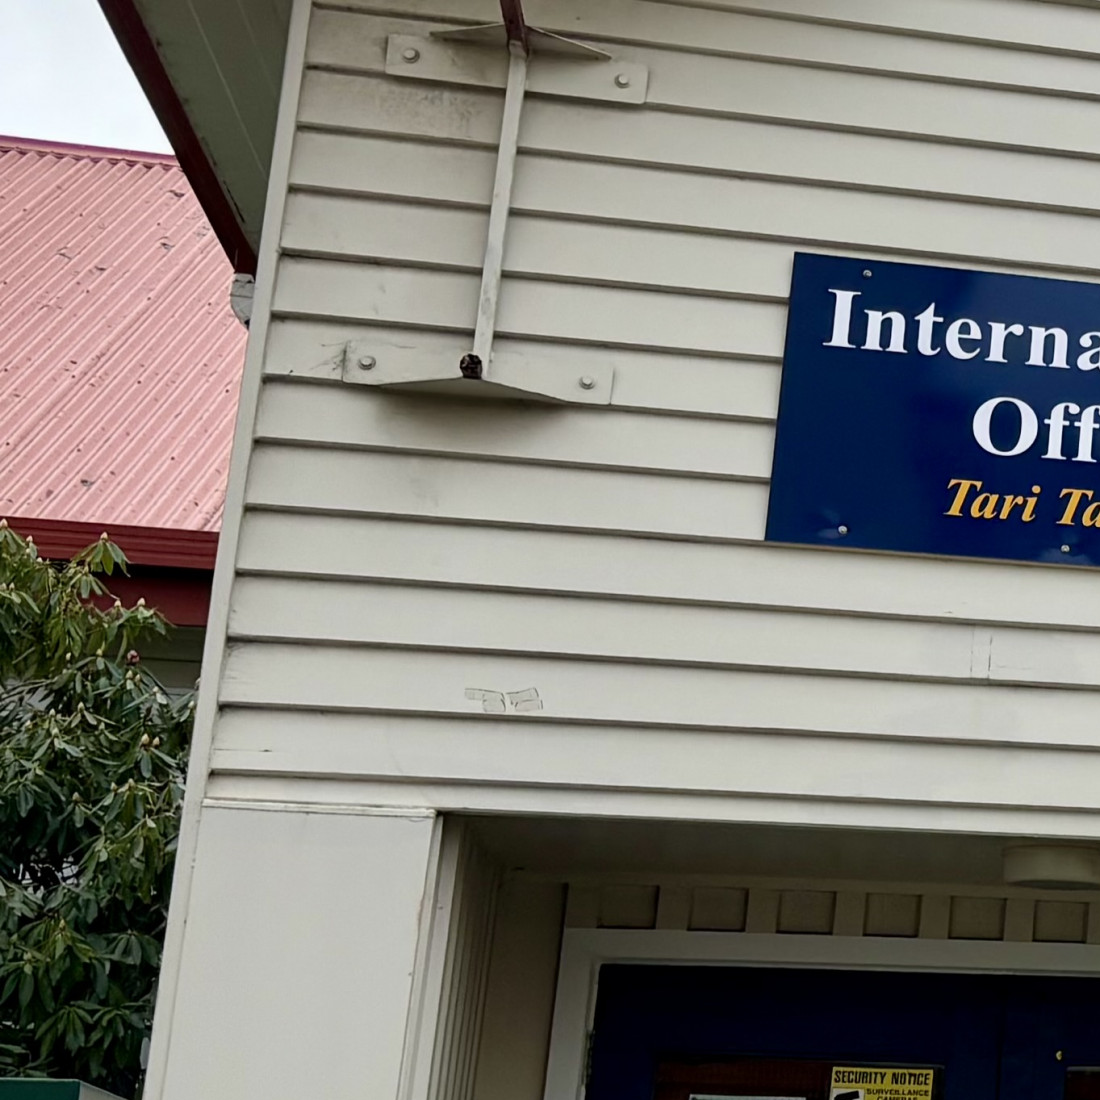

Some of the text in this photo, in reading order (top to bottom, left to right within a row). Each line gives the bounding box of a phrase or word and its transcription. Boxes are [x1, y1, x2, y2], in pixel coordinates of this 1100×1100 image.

[943, 479, 1041, 522] Tari
[834, 1070, 931, 1085] SECURITY NOTICE
[866, 1088, 930, 1097] SURVEILLANCE
